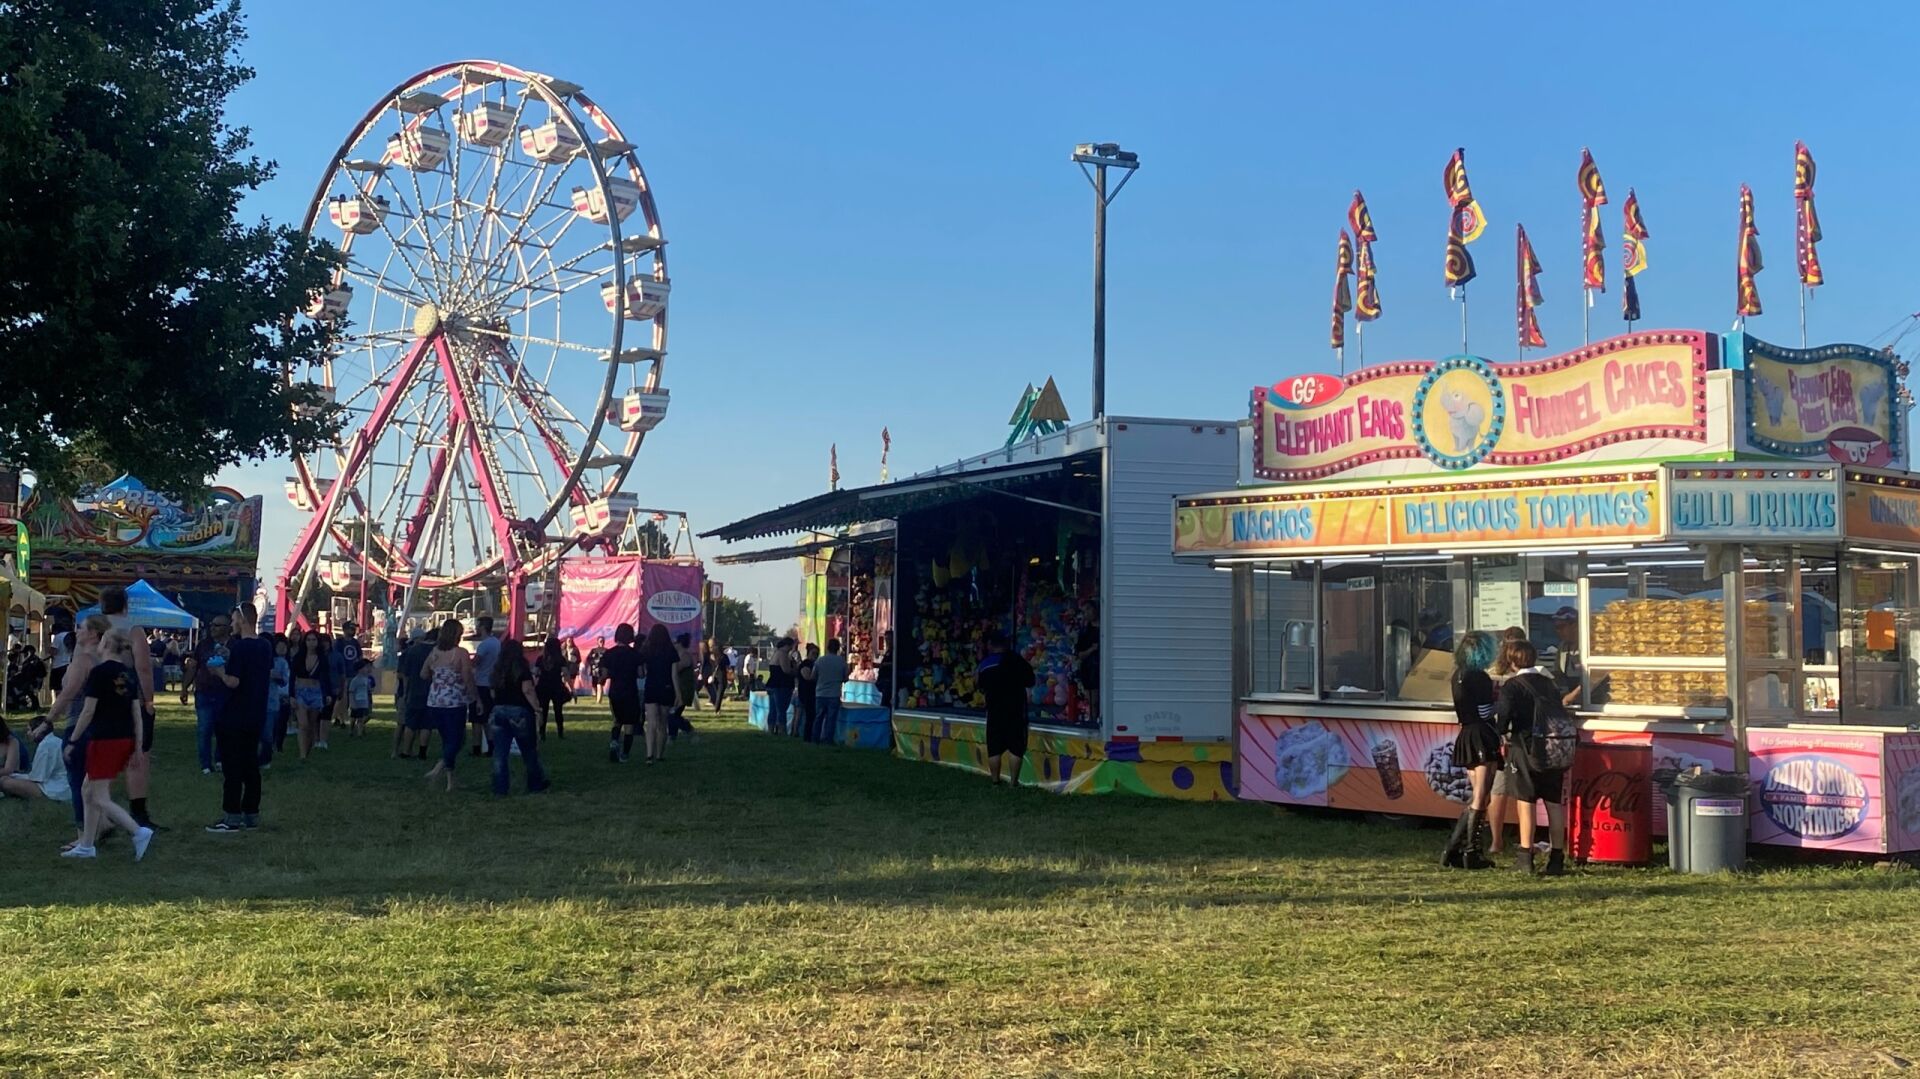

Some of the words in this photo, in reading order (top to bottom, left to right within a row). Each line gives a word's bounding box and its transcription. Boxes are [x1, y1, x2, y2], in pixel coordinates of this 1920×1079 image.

[1512, 382, 1602, 439] FUNNEL
[1604, 360, 1687, 415] CAKES
[1274, 406, 1355, 457] ELEPHANT
[1357, 396, 1405, 441] EARS
[1232, 506, 1313, 542] NACHOS
[1404, 497, 1521, 535] DELICIOUS
[1525, 489, 1650, 530] TOPPINGS
[1674, 490, 1734, 527] COLD
[1745, 490, 1836, 528] DRINKS
[1761, 737, 1774, 746] No
[1765, 759, 1814, 795] DAVIS
[1816, 759, 1865, 798] SHOWS
[1772, 803, 1861, 836] NORTHWEST
